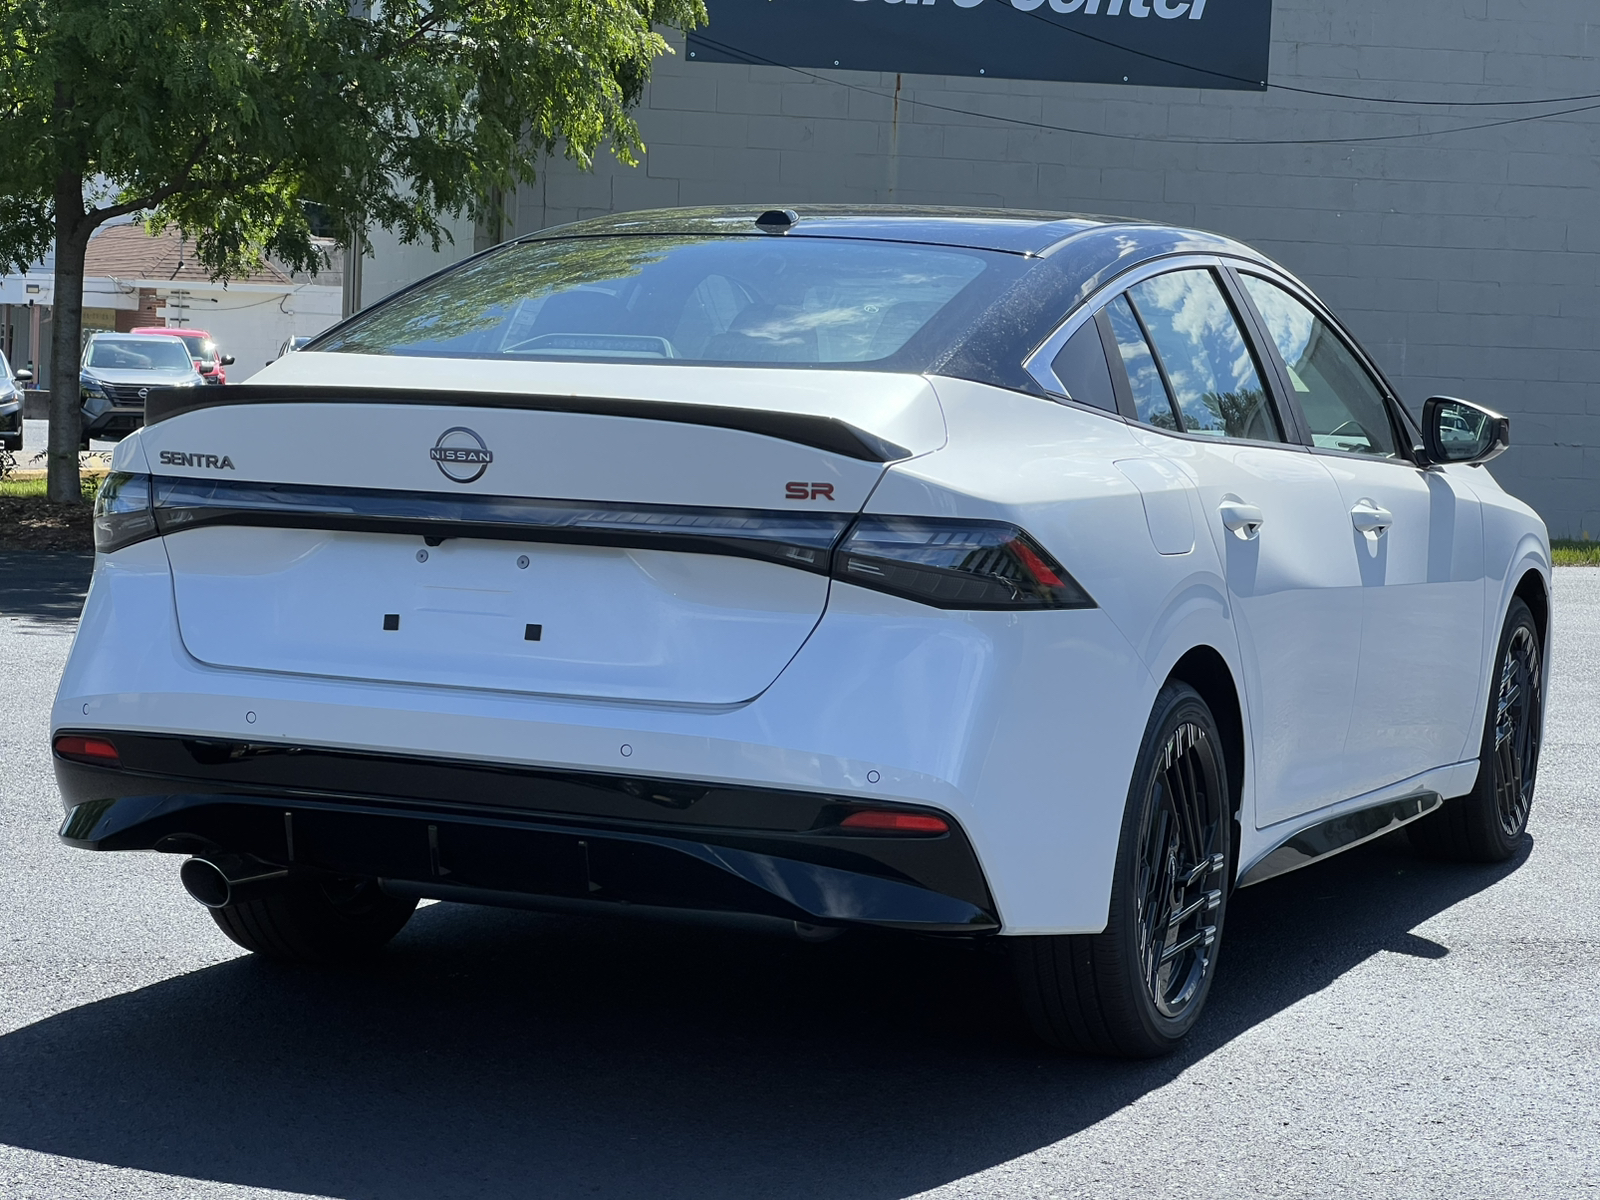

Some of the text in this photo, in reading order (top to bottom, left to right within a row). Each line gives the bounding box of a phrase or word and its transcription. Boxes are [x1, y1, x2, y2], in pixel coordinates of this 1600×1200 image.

[159, 450, 236, 470] SENTRA
[431, 449, 490, 462] NISSAN
[785, 481, 836, 501] SR
